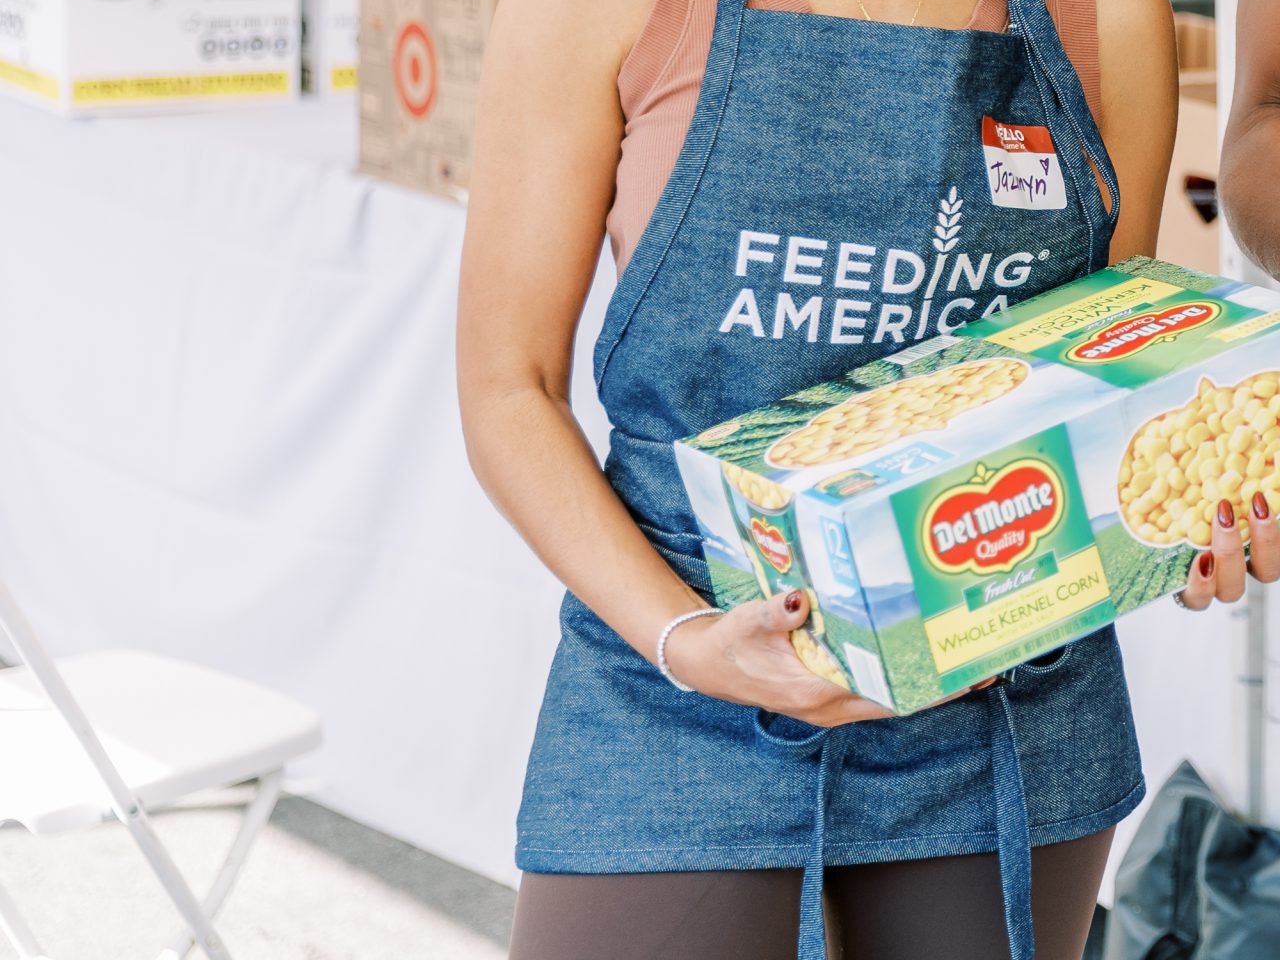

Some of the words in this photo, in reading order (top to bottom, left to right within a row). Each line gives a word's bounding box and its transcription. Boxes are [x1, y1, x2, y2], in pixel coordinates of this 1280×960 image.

[1071, 284, 1153, 318] KERNEL
[1166, 304, 1209, 327] Del
[1008, 313, 1073, 342] CORN
[1081, 319, 1168, 359] Monte
[1104, 315, 1156, 339] Quality
[933, 511, 978, 554] Del
[973, 481, 1054, 536] Monte
[976, 529, 1025, 559] Quality
[937, 620, 996, 655] WHOLE
[998, 595, 1055, 628] KERNEL
[1056, 572, 1101, 602] CORN
